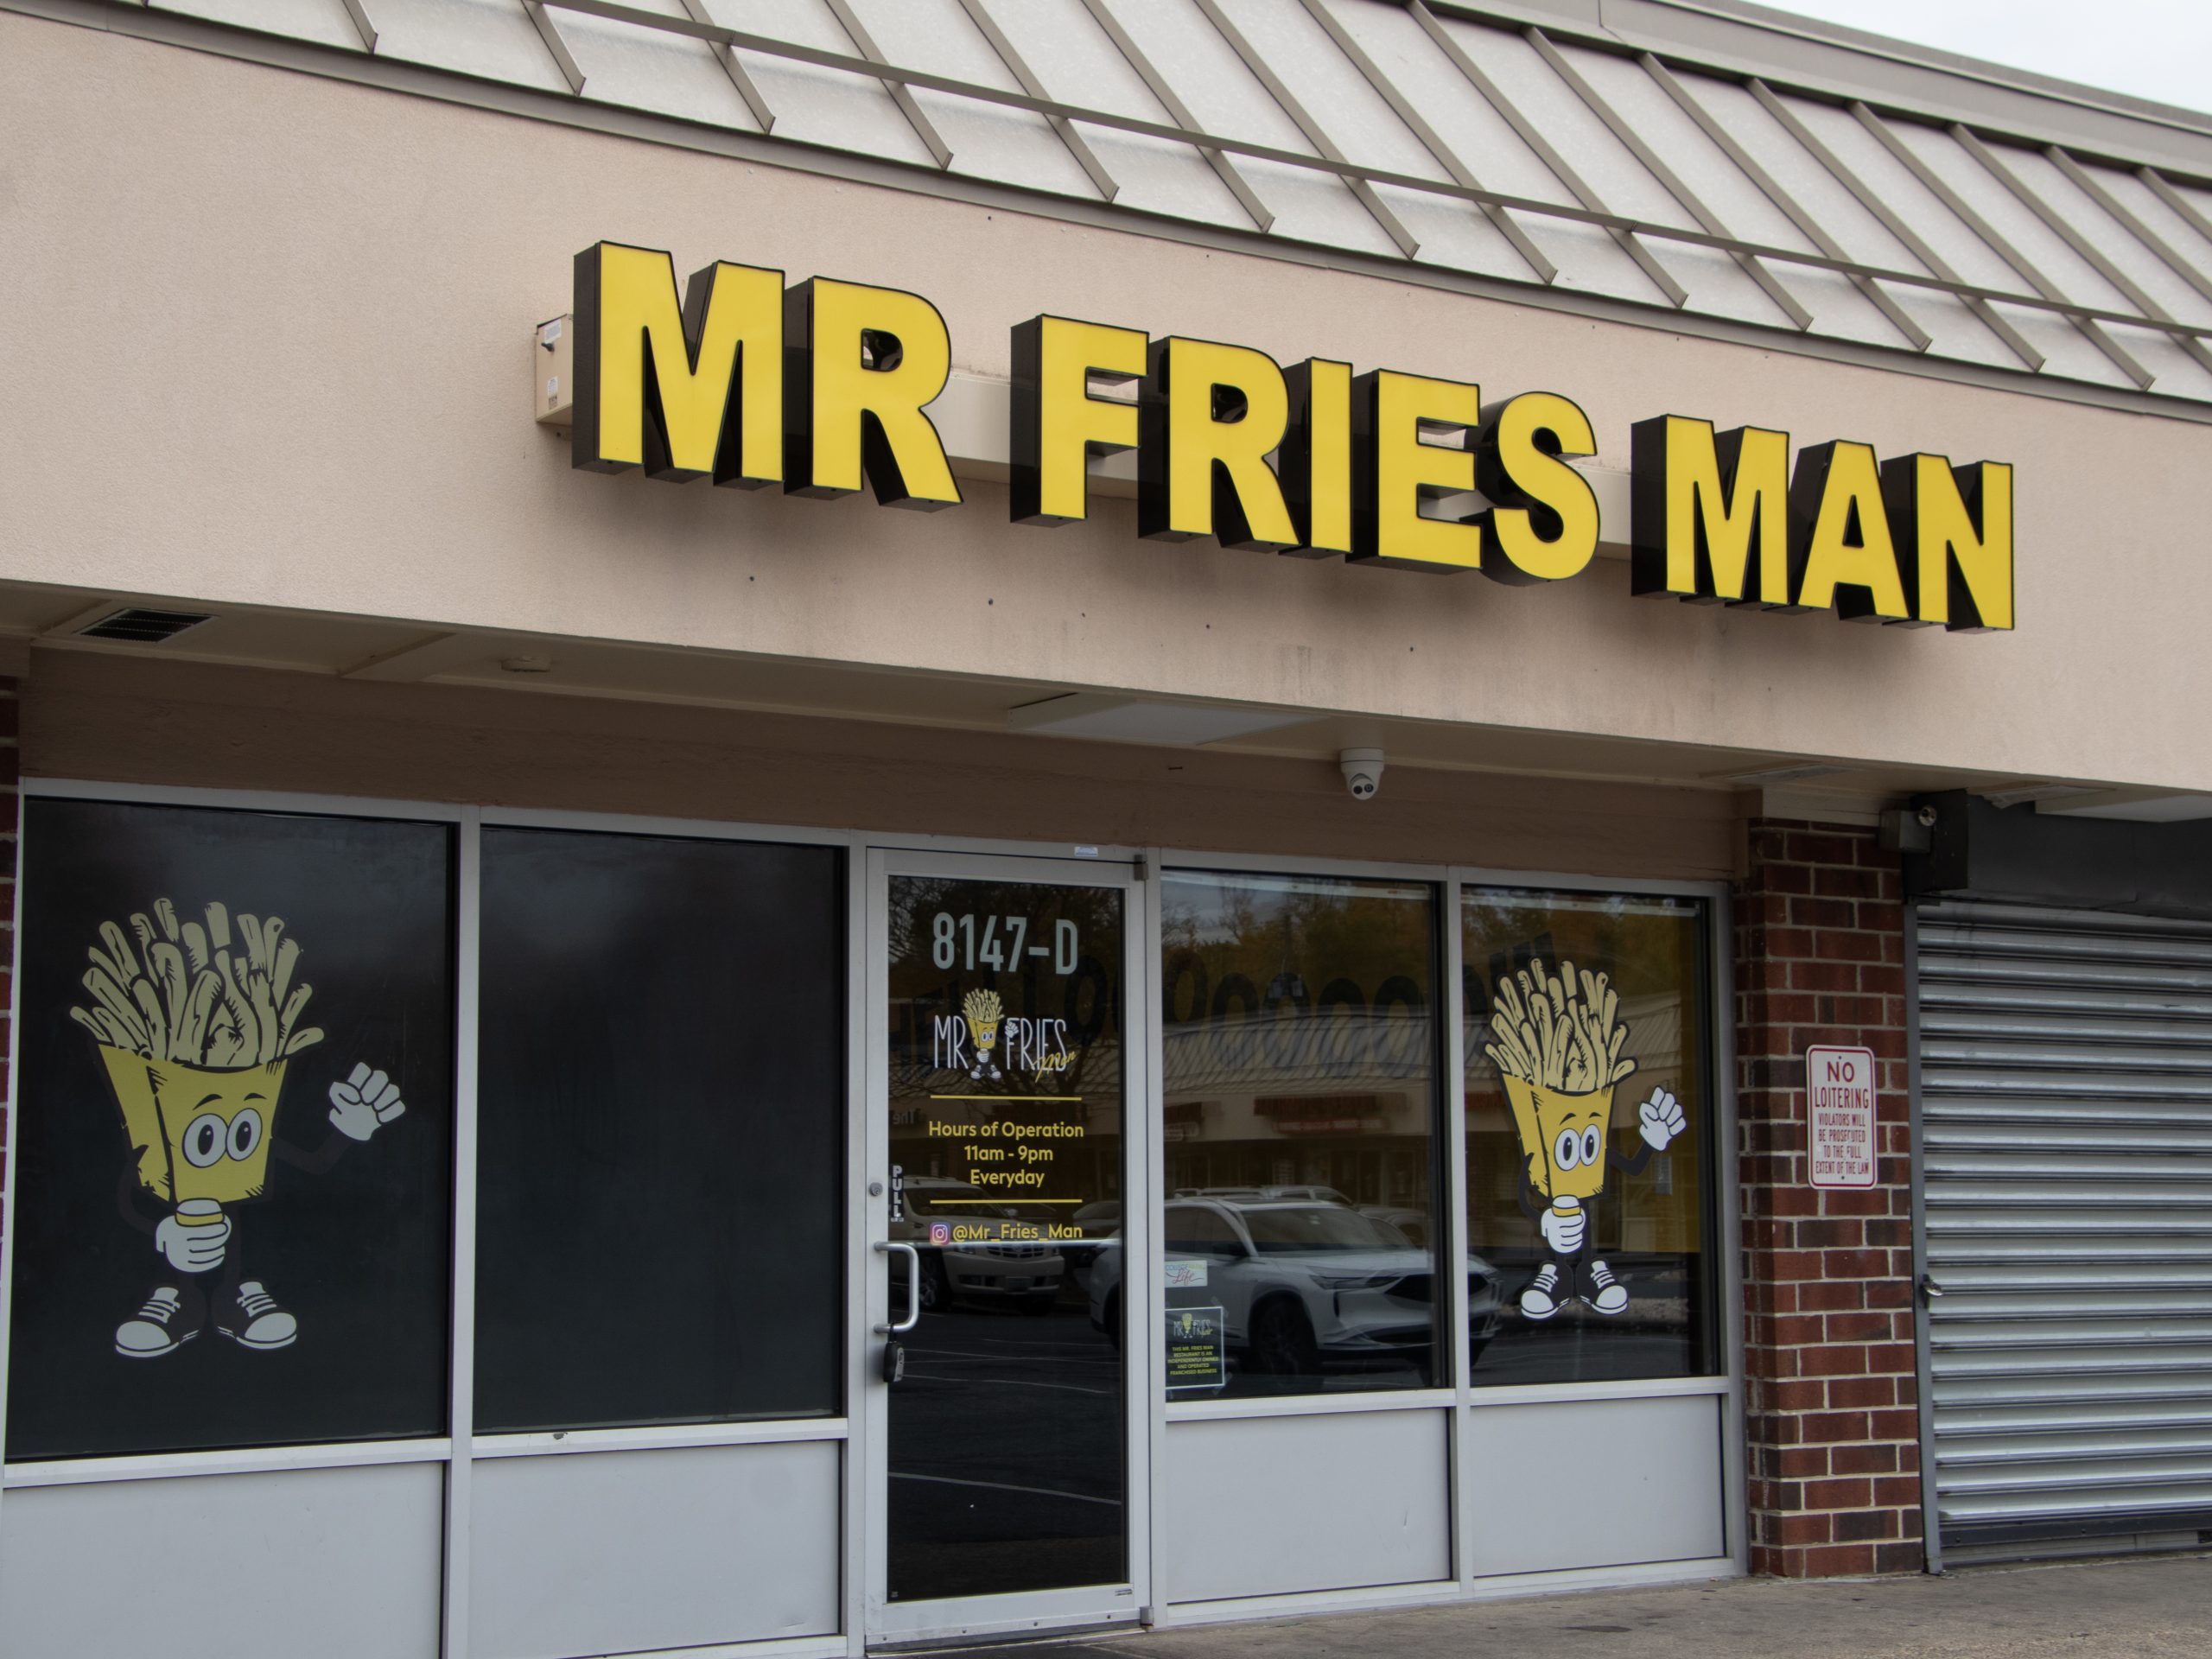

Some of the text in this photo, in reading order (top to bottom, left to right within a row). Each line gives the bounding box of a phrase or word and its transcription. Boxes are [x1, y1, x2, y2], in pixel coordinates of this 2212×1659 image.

[595, 240, 2014, 632] MR FRIES MAN
[933, 912, 1078, 975] 8147-D
[934, 1014, 1067, 1071] MR FRIES
[1031, 1051, 1077, 1084] Man
[1827, 1061, 1855, 1083] NO
[1815, 1087, 1869, 1109] LOITERING
[1818, 1113, 1866, 1127] VIOLATORS WILL
[929, 1121, 1084, 1141] Hours of Operation
[1819, 1129, 1826, 1142] BE
[964, 1146, 1004, 1160] 11am
[1018, 1146, 1053, 1164] 9pm
[1824, 1145, 1861, 1159] TO THE FULL
[1816, 1161, 1869, 1175] EXTENT OF THE LAW
[970, 1169, 1045, 1188] Everyday
[892, 1165, 903, 1217] PULL
[952, 1224, 1083, 1242] @Mr_Fries_Man
